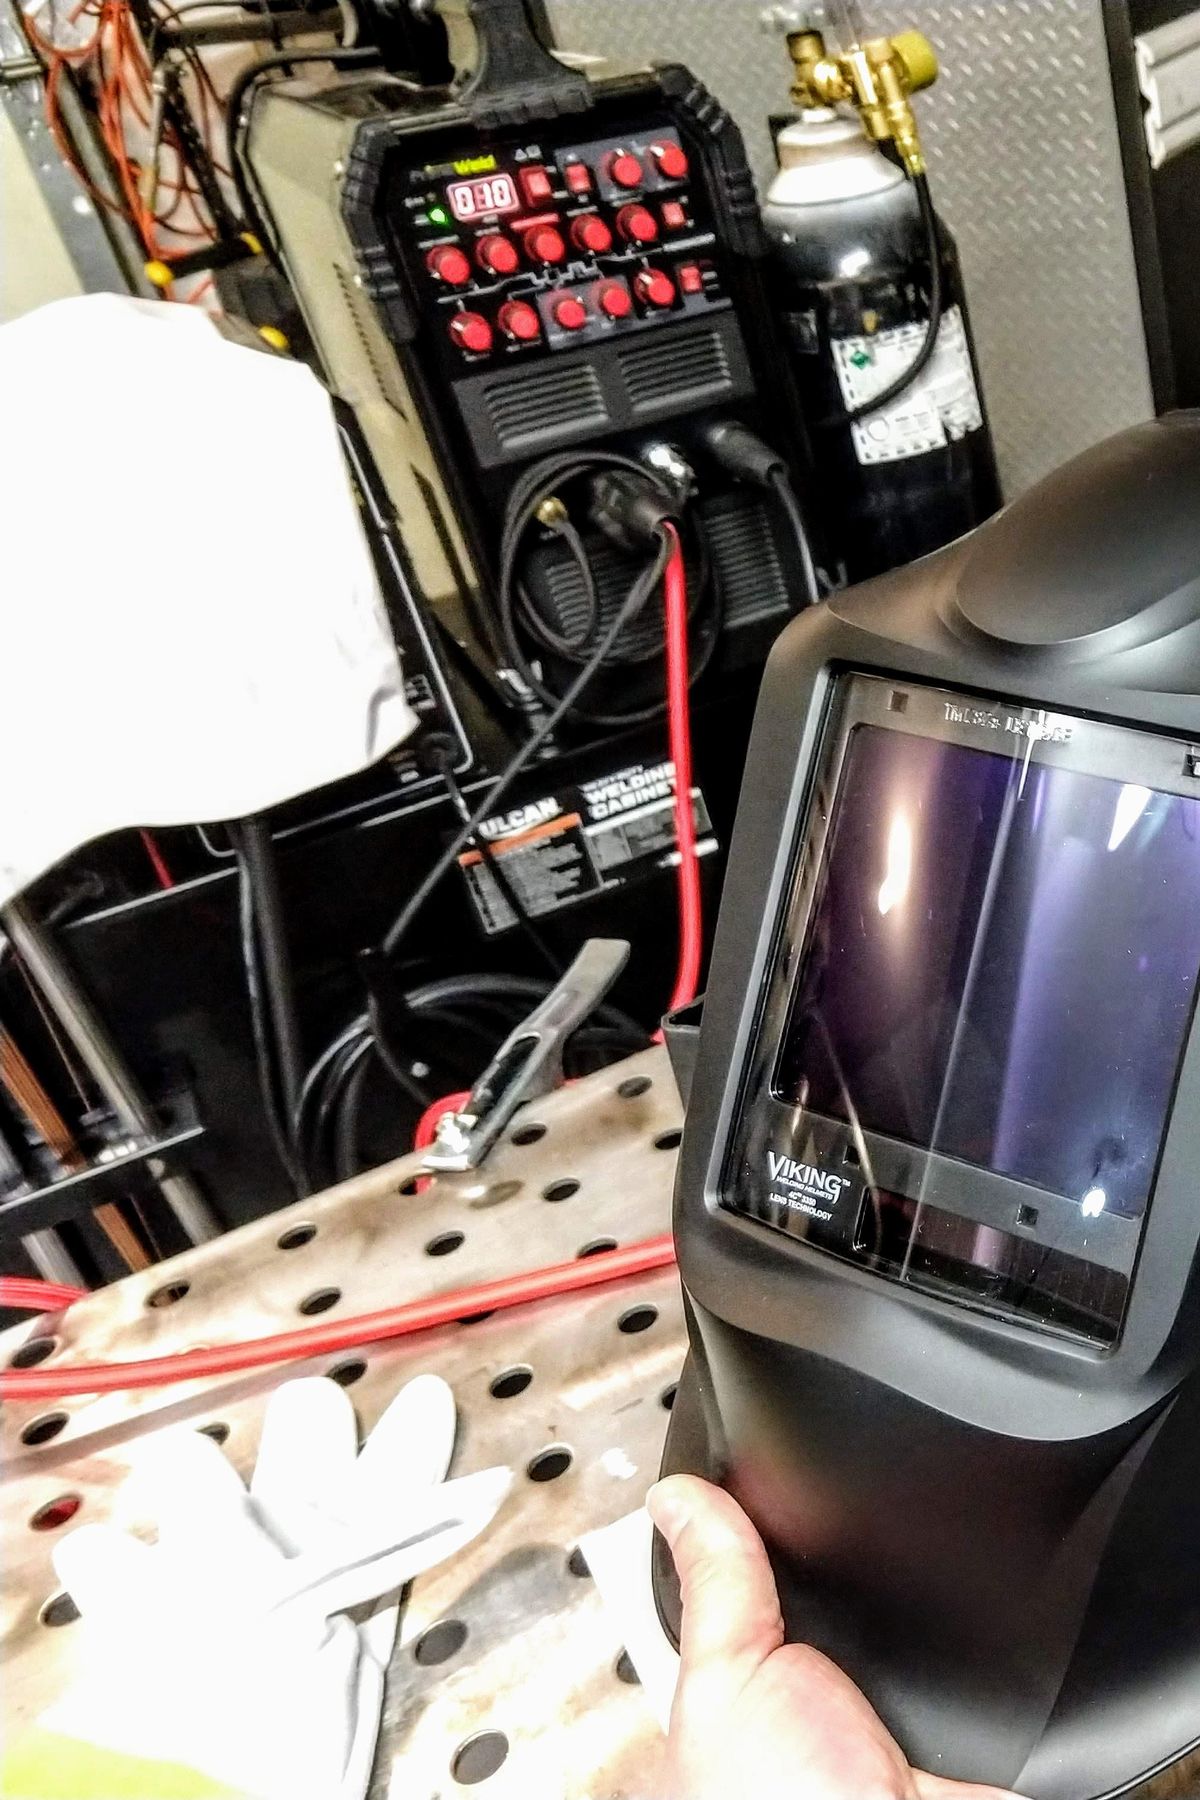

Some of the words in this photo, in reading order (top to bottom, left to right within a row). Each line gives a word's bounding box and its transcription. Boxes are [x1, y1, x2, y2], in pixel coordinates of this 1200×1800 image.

[478, 797, 562, 839] ULCAN
[769, 1192, 788, 1206] LENS
[787, 1198, 833, 1221] TECHNOLOGY
[804, 1185, 834, 1200] HELMETS
